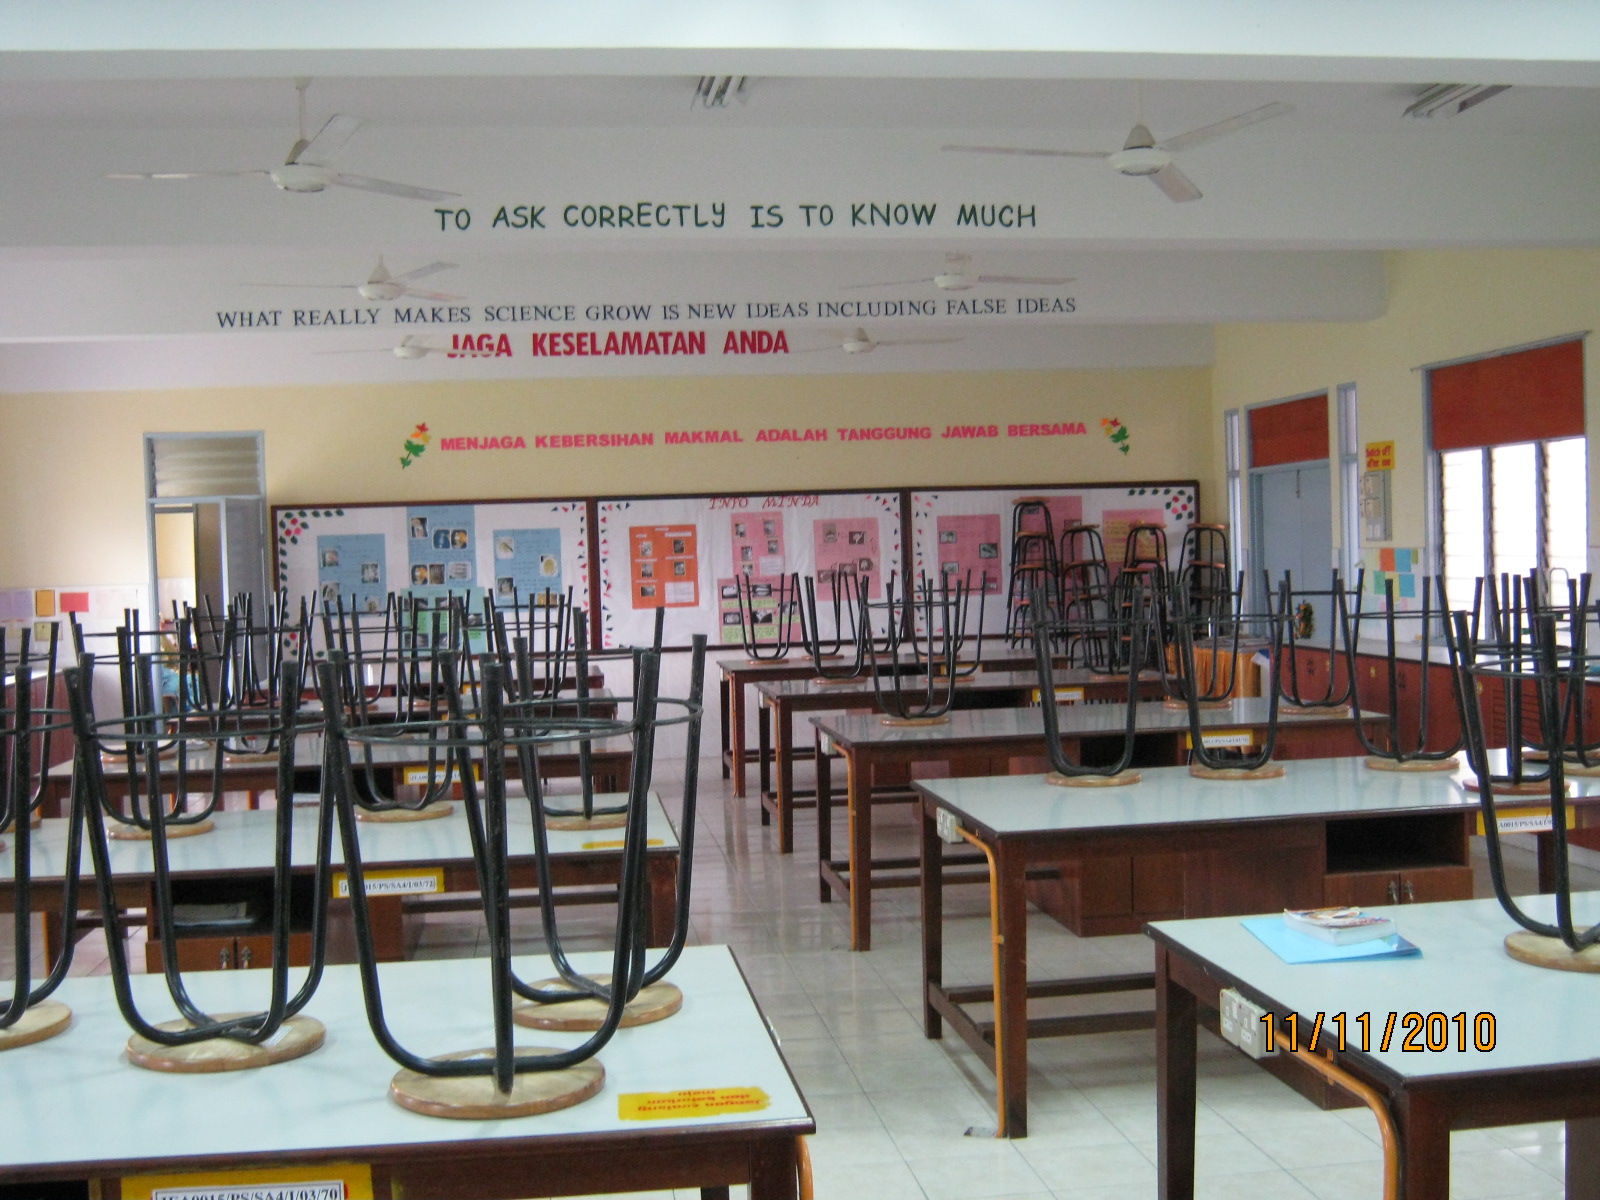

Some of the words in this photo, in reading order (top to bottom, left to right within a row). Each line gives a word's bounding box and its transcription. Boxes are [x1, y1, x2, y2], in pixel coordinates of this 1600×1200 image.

[434, 209, 470, 231] TO
[492, 206, 545, 230] ASK
[563, 203, 726, 230] CORRECTLY
[750, 205, 784, 228] IS
[799, 204, 834, 228] TO
[851, 203, 937, 228] KNOW
[956, 204, 1036, 229] MUCH
[217, 311, 282, 328] WHAT
[293, 309, 379, 327] REALLY
[394, 307, 471, 324] MAKES
[484, 305, 576, 323] SCIENCE
[585, 304, 652, 322] GROW
[662, 303, 680, 321] IS
[687, 302, 736, 320] NEW
[747, 302, 809, 319] IDEAS
[817, 300, 937, 318] INCLUDING
[946, 299, 1007, 315] FALSE
[1017, 297, 1077, 314] IDEAS
[447, 333, 513, 359] JAGA
[532, 331, 706, 357] KESELAMATAN
[723, 330, 790, 355] ANDA
[440, 436, 526, 452] MENJAGA
[535, 433, 655, 450] KEBERSIHAN
[664, 431, 743, 446] MAKMAL
[755, 429, 828, 444] ADALAH
[837, 427, 932, 442] TANGGUNG
[941, 425, 998, 440] JAWAB
[1007, 422, 1087, 438] BERSAMA
[709, 496, 750, 510] INFO
[762, 494, 820, 510] MINDA
